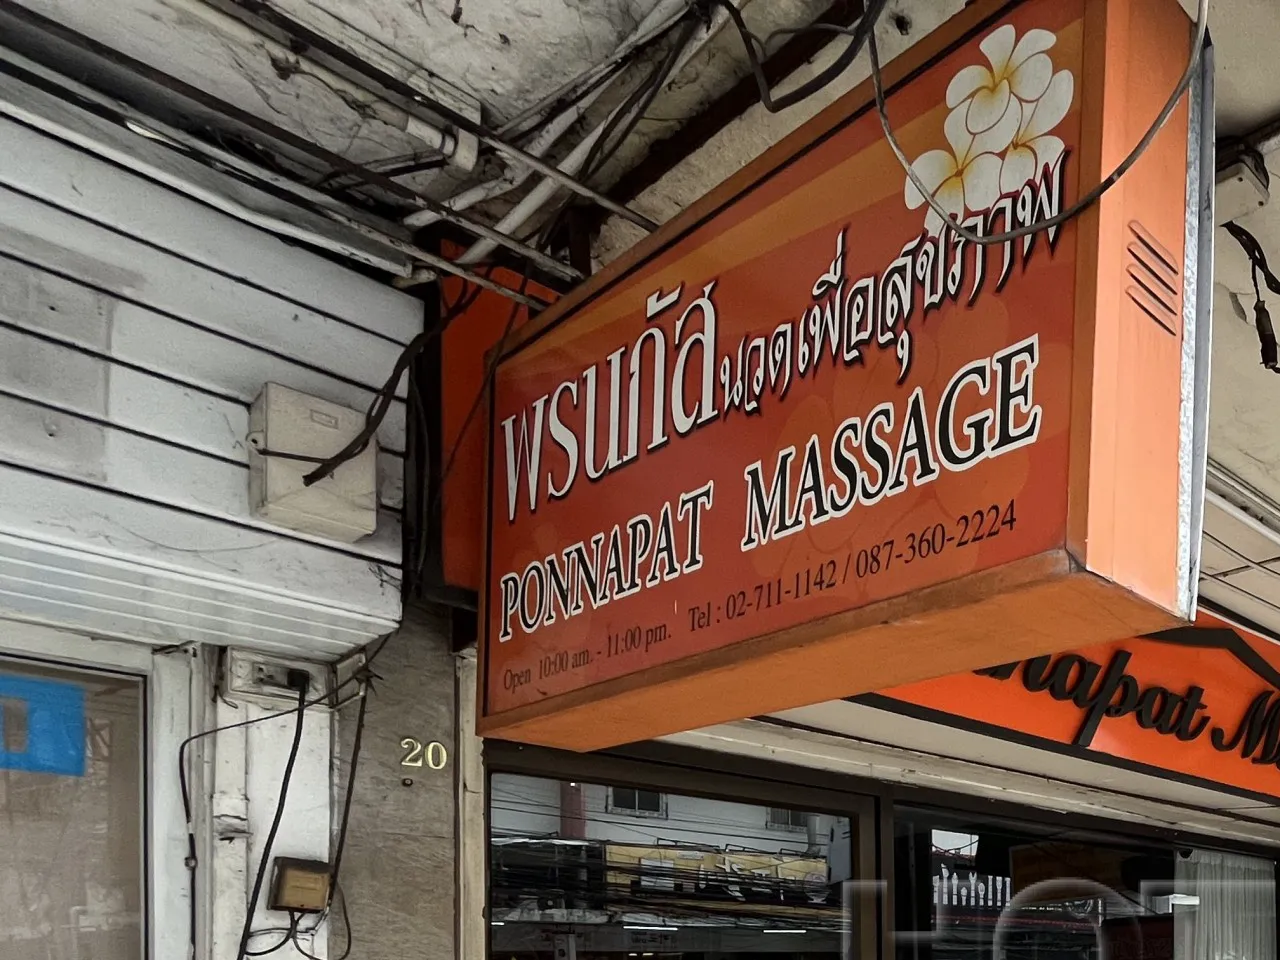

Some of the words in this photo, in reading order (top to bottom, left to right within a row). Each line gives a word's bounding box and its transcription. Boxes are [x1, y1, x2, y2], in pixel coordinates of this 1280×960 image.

[499, 480, 714, 643] PONNAPAT
[741, 333, 1042, 552] MASSAGE
[501, 280, 718, 520] พรนภัส
[503, 669, 531, 693] Open
[538, 651, 569, 680] 10:00
[606, 626, 642, 658] 11:00
[645, 623, 672, 653] pm.
[688, 602, 711, 632] Tel
[725, 559, 837, 621] 02-711-1142
[856, 499, 1017, 579] 087-360-2224
[400, 738, 447, 770] 20
